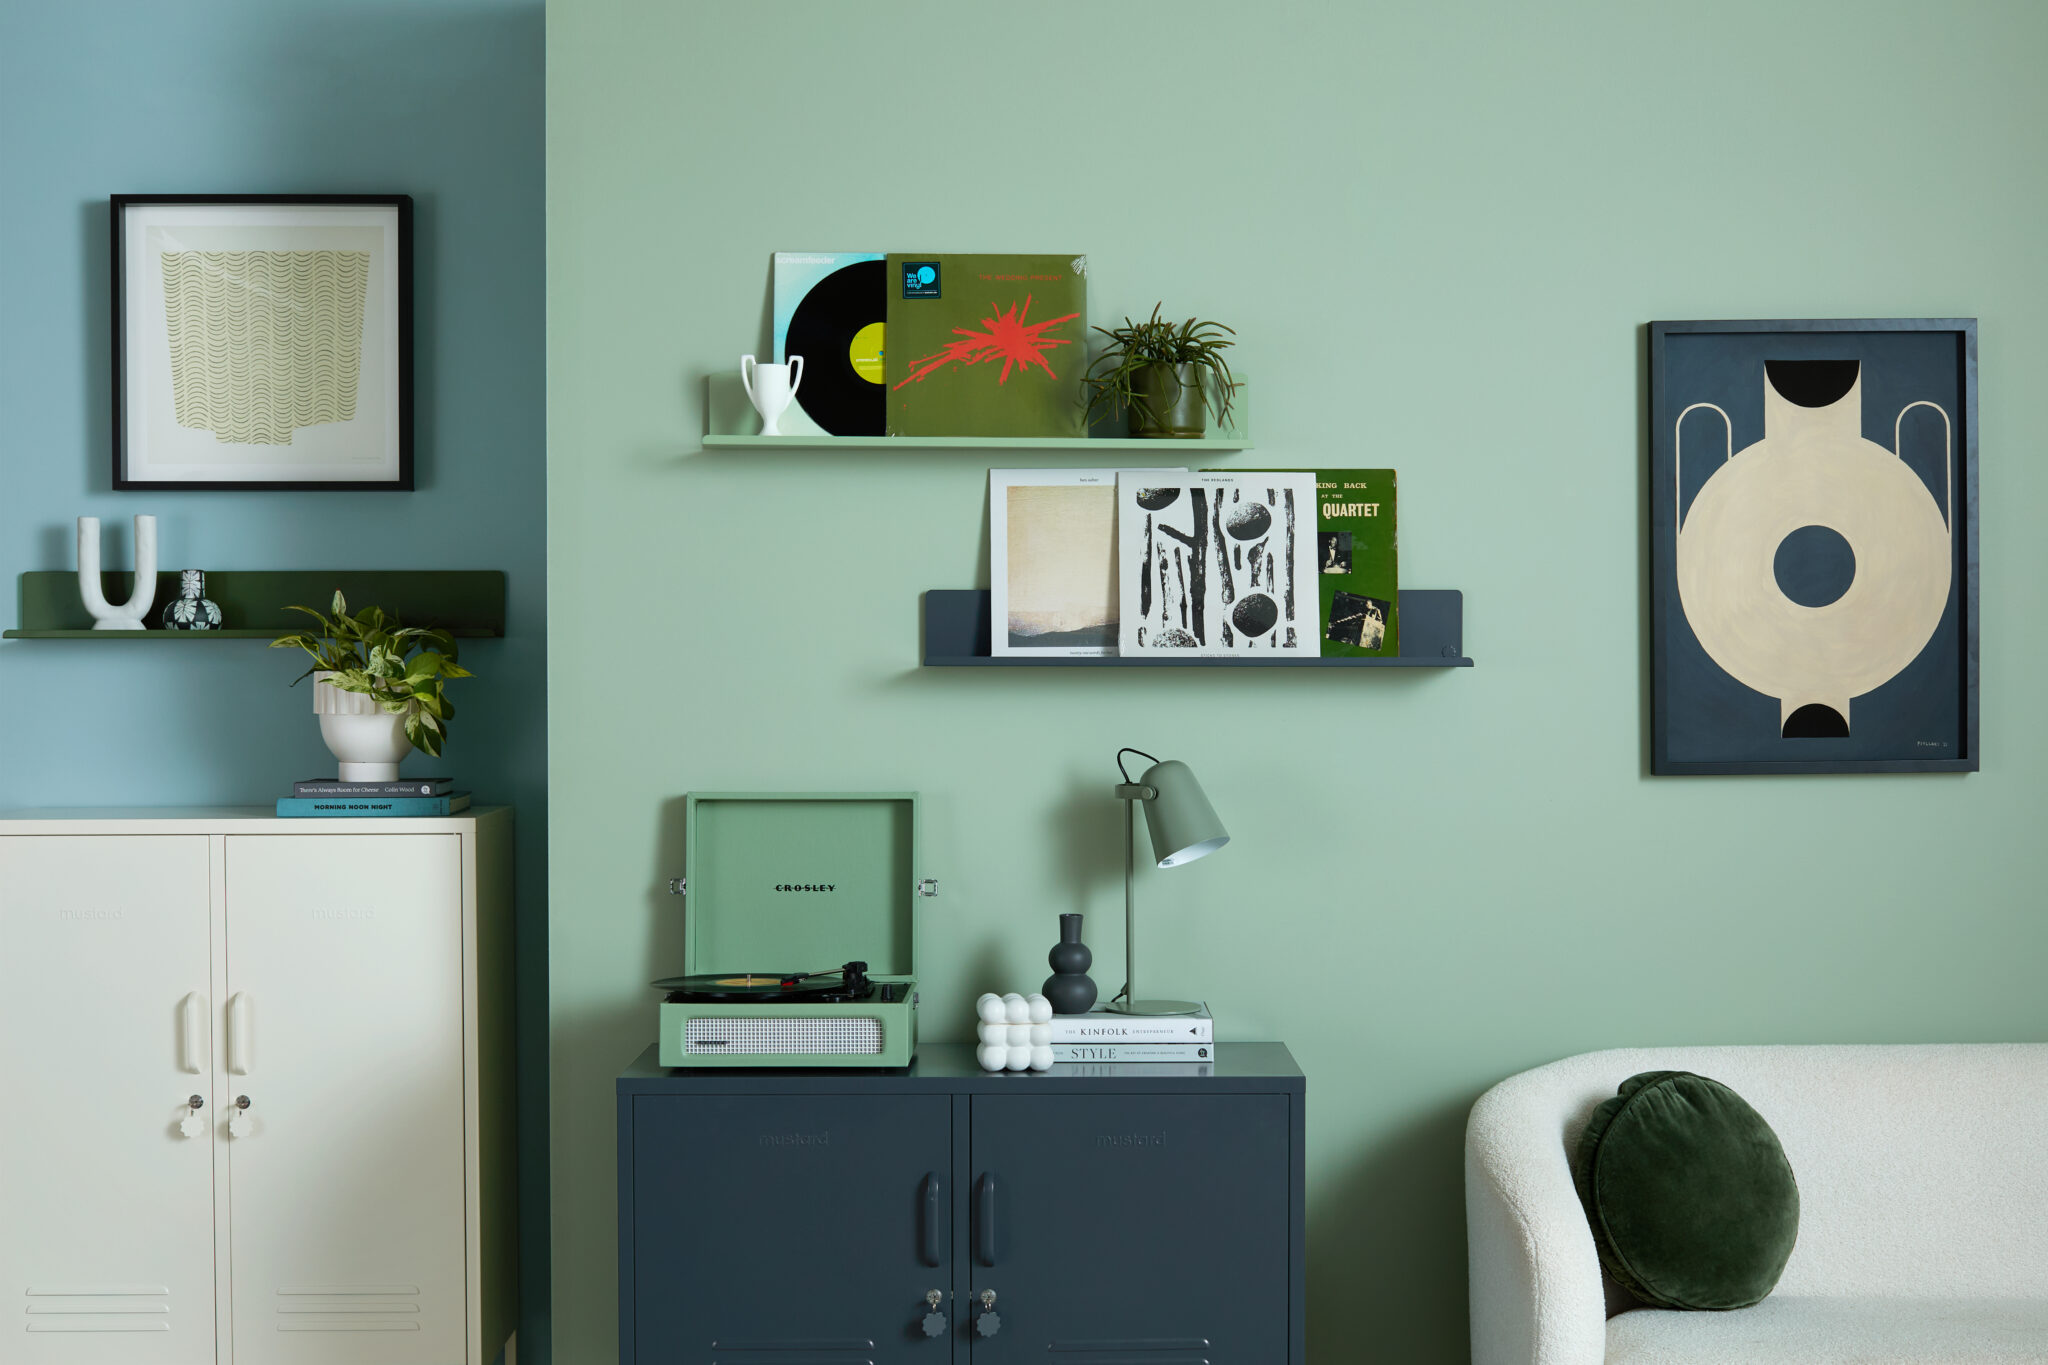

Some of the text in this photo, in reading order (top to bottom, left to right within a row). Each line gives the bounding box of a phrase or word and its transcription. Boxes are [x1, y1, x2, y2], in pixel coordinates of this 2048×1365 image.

[1322, 502, 1380, 520] QUARTET
[774, 884, 836, 892] CROSLEY
[58, 904, 125, 921] mustard
[311, 904, 377, 921] mustard
[1080, 1028, 1128, 1036] KINFOLK
[1071, 1048, 1117, 1059] STYLE
[759, 1130, 829, 1147] mustard
[1096, 1130, 1167, 1147] mustard
